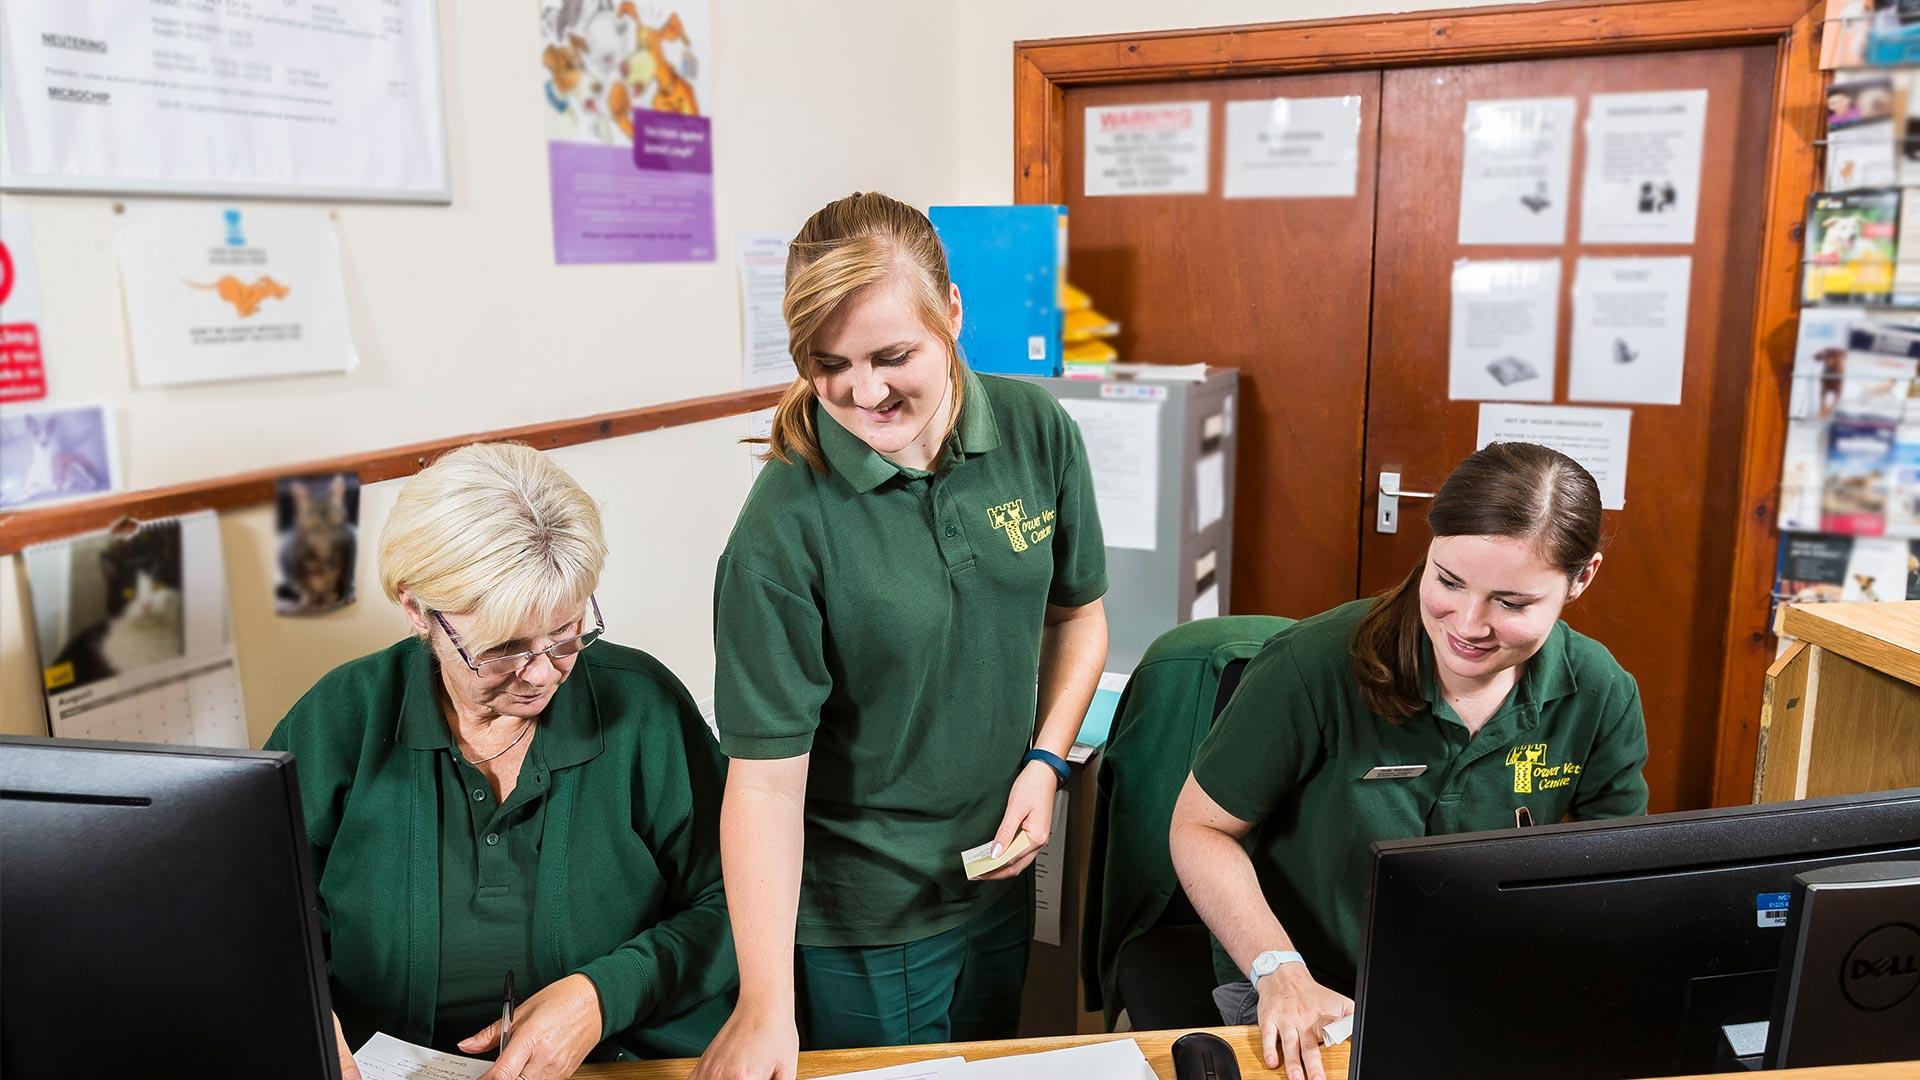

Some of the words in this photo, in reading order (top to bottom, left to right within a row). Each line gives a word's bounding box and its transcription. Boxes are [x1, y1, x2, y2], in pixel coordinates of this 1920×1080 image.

[42, 33, 107, 53] NEUTERING
[48, 87, 111, 104] MICROCHIP
[1100, 108, 1192, 130] WARNING
[1041, 509, 1056, 523] Vet
[1563, 762, 1581, 774] Vet
[1538, 777, 1571, 791] Centre
[1850, 955, 1919, 979] DELL
